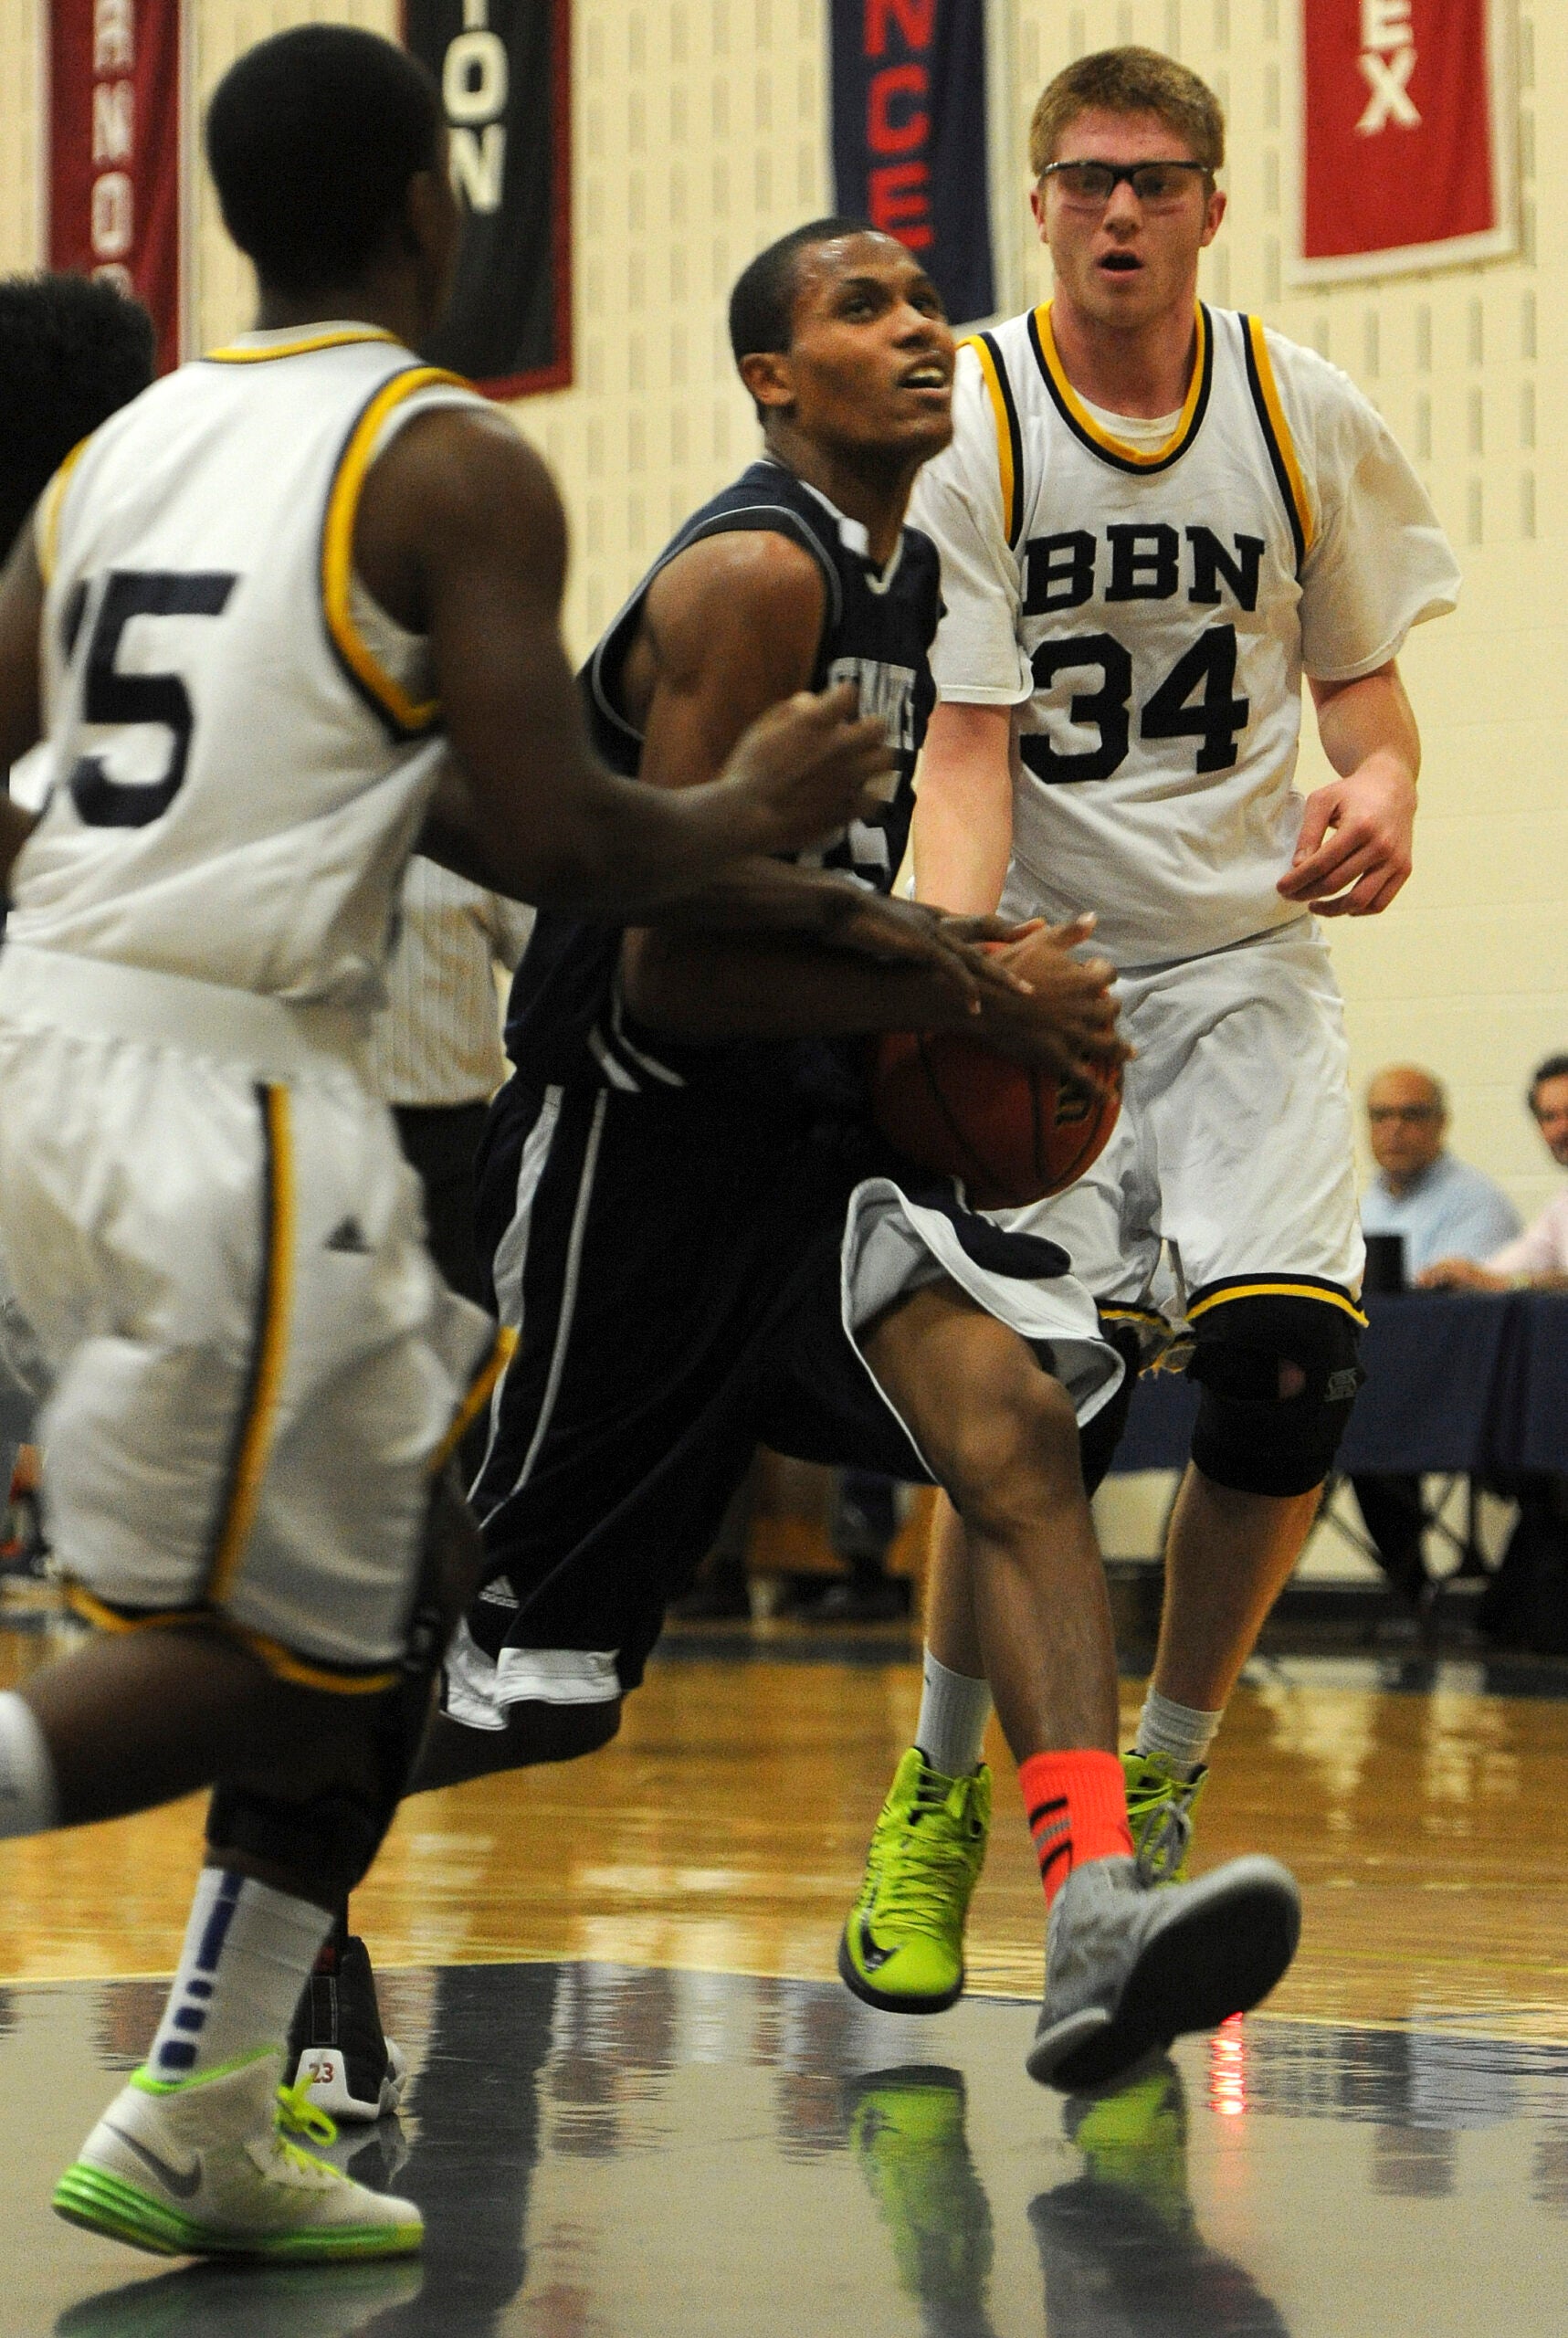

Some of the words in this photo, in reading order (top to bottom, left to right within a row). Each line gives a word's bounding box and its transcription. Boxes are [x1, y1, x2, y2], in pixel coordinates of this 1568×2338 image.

[864, 0, 934, 249] NCE
[1353, 0, 1422, 137] EX
[1023, 523, 1265, 616] BBN
[58, 570, 240, 828] 5
[1019, 624, 1249, 785] 34
[309, 2062, 333, 2083] 23
